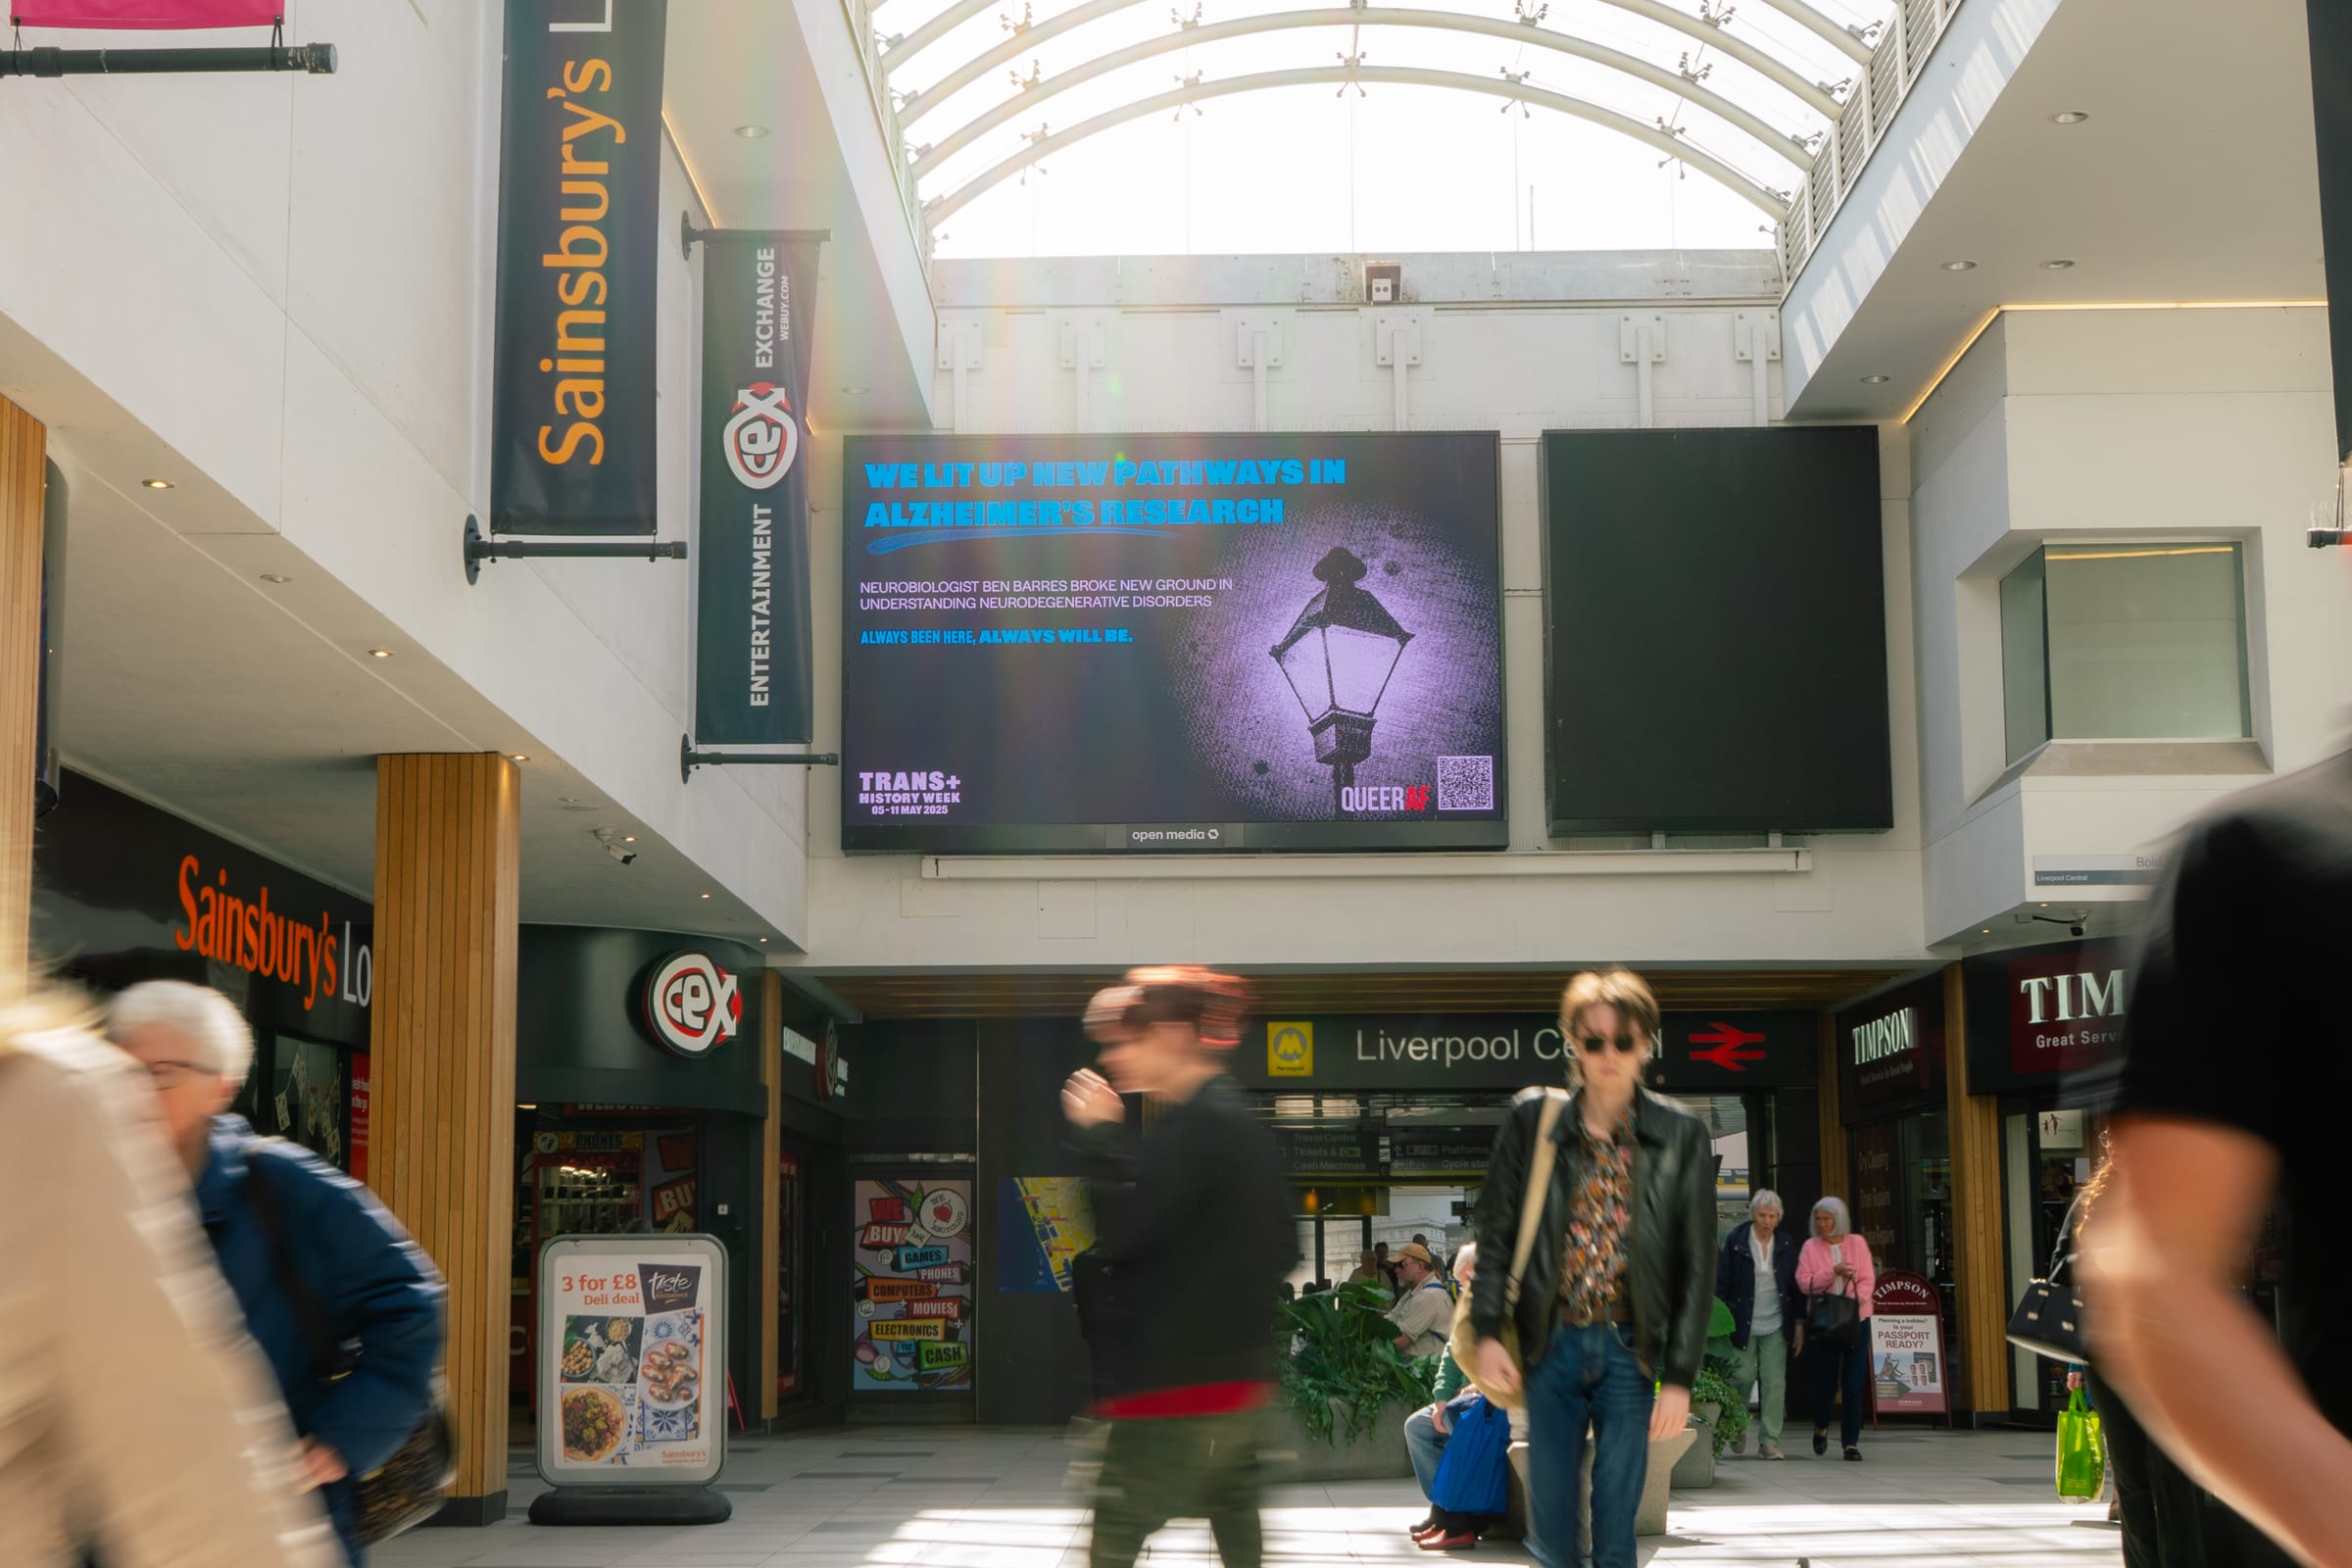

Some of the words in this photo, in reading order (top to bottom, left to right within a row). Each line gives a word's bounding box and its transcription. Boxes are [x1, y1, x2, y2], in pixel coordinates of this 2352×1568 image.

[539, 58, 625, 466] Sainsbury's
[756, 248, 774, 368] EXCHANGE
[779, 275, 790, 341] WEBUY.COM
[863, 462, 918, 488] WE
[924, 462, 975, 487] LIT
[978, 461, 1028, 487] UP
[1033, 461, 1109, 487] NEW
[1113, 459, 1305, 486] PATHWAYS
[1309, 459, 1347, 484] IN
[863, 500, 1096, 527] ALZHEIMER'S
[1100, 498, 1285, 525] RESEARCH
[859, 580, 979, 594] NEUROBIOLOGIST
[982, 580, 1010, 593] BEN
[1012, 579, 1068, 593] BARRES
[1070, 579, 1117, 592] BROKE
[1120, 579, 1152, 591] NEW
[1155, 578, 1217, 591] GROUND
[1219, 578, 1233, 590] IN
[750, 504, 771, 707] ENTERTAINMENT
[859, 598, 977, 611] UNDERSTANDING
[980, 596, 1130, 609] NEURODEGENERATIVE
[1132, 595, 1213, 608] DISORDERS
[860, 630, 908, 645] ALWAYS
[910, 630, 941, 644] BEEN
[943, 629, 976, 646] HERE,
[978, 628, 1056, 644] ALWAYS
[1057, 628, 1102, 643] WILL
[1104, 627, 1134, 643] BE.
[858, 770, 961, 792] TRANS+
[858, 792, 920, 804] HISTORY
[922, 792, 960, 804] WEEK
[901, 805, 922, 815] MAY
[923, 805, 949, 814] 2025
[1132, 831, 1164, 843] open
[1166, 828, 1205, 840] media
[2036, 875, 2065, 884] Liverpool
[174, 855, 338, 1011] Sainsbury's
[1852, 1006, 1916, 1066] TIMPSON
[2035, 1033, 2076, 1049] Great
[1356, 1029, 1519, 1067] Liverpool
[575, 1133, 622, 1148] PHONES
[869, 1225, 903, 1244] BUY
[905, 1250, 942, 1264] GAMES
[920, 1267, 958, 1281] PHONES
[562, 1276, 574, 1292] 3
[578, 1274, 607, 1292] for
[612, 1273, 637, 1291] £8
[872, 1284, 933, 1297] COMPUTERS
[1873, 1280, 1930, 1299] TIMPSON
[583, 1294, 610, 1306] Deli
[612, 1292, 641, 1305] deal
[912, 1301, 954, 1316] MOVIES
[874, 1324, 940, 1337] ELECTRONICS
[1878, 1331, 1931, 1341] PASSPORT
[1886, 1341, 1925, 1349] READY?
[925, 1347, 962, 1364] CASH
